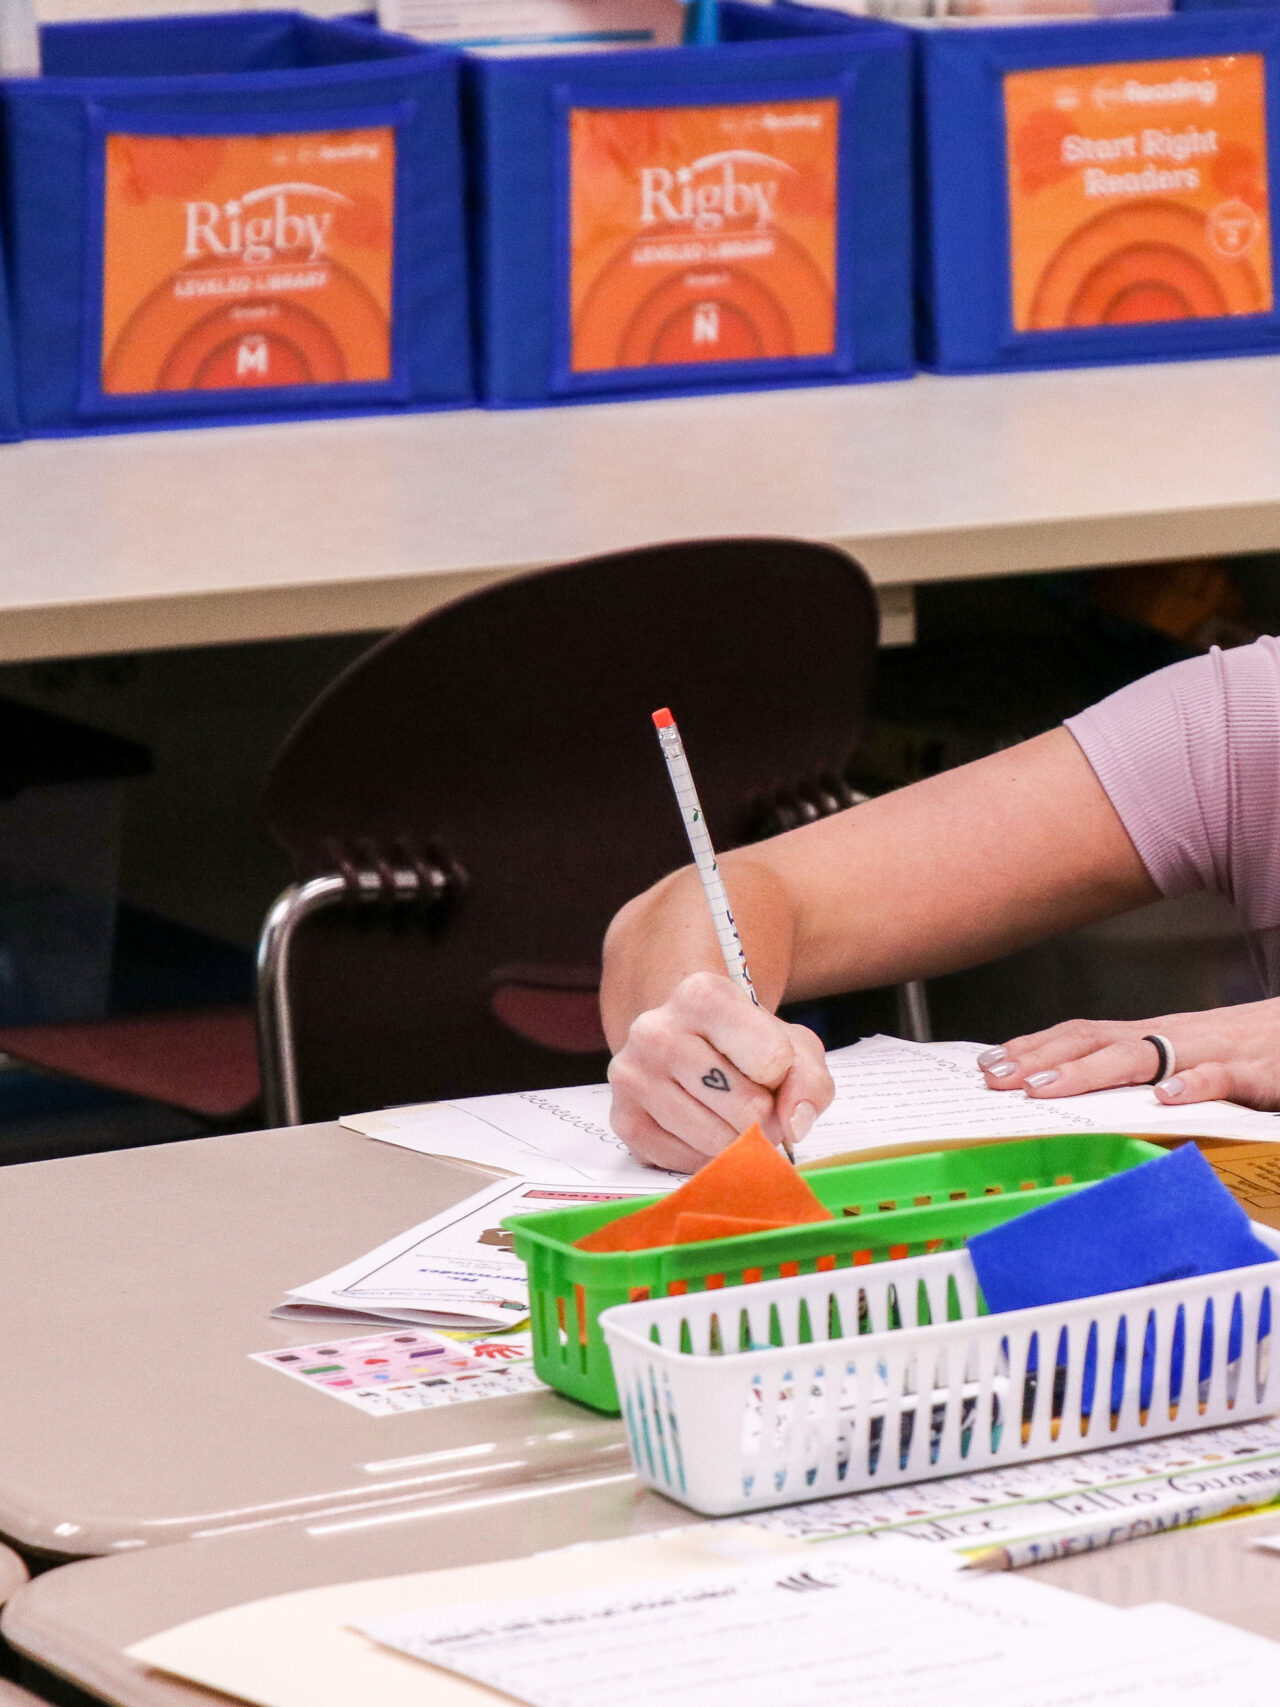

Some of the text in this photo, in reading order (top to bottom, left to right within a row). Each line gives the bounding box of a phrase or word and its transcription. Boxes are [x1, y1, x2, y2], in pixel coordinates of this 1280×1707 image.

[1061, 125, 1218, 164] Start Right
[1083, 161, 1200, 195] Readers
[640, 162, 779, 232] Rigby
[184, 195, 332, 264] Rigby
[692, 311, 720, 344] N
[236, 345, 268, 376] M
